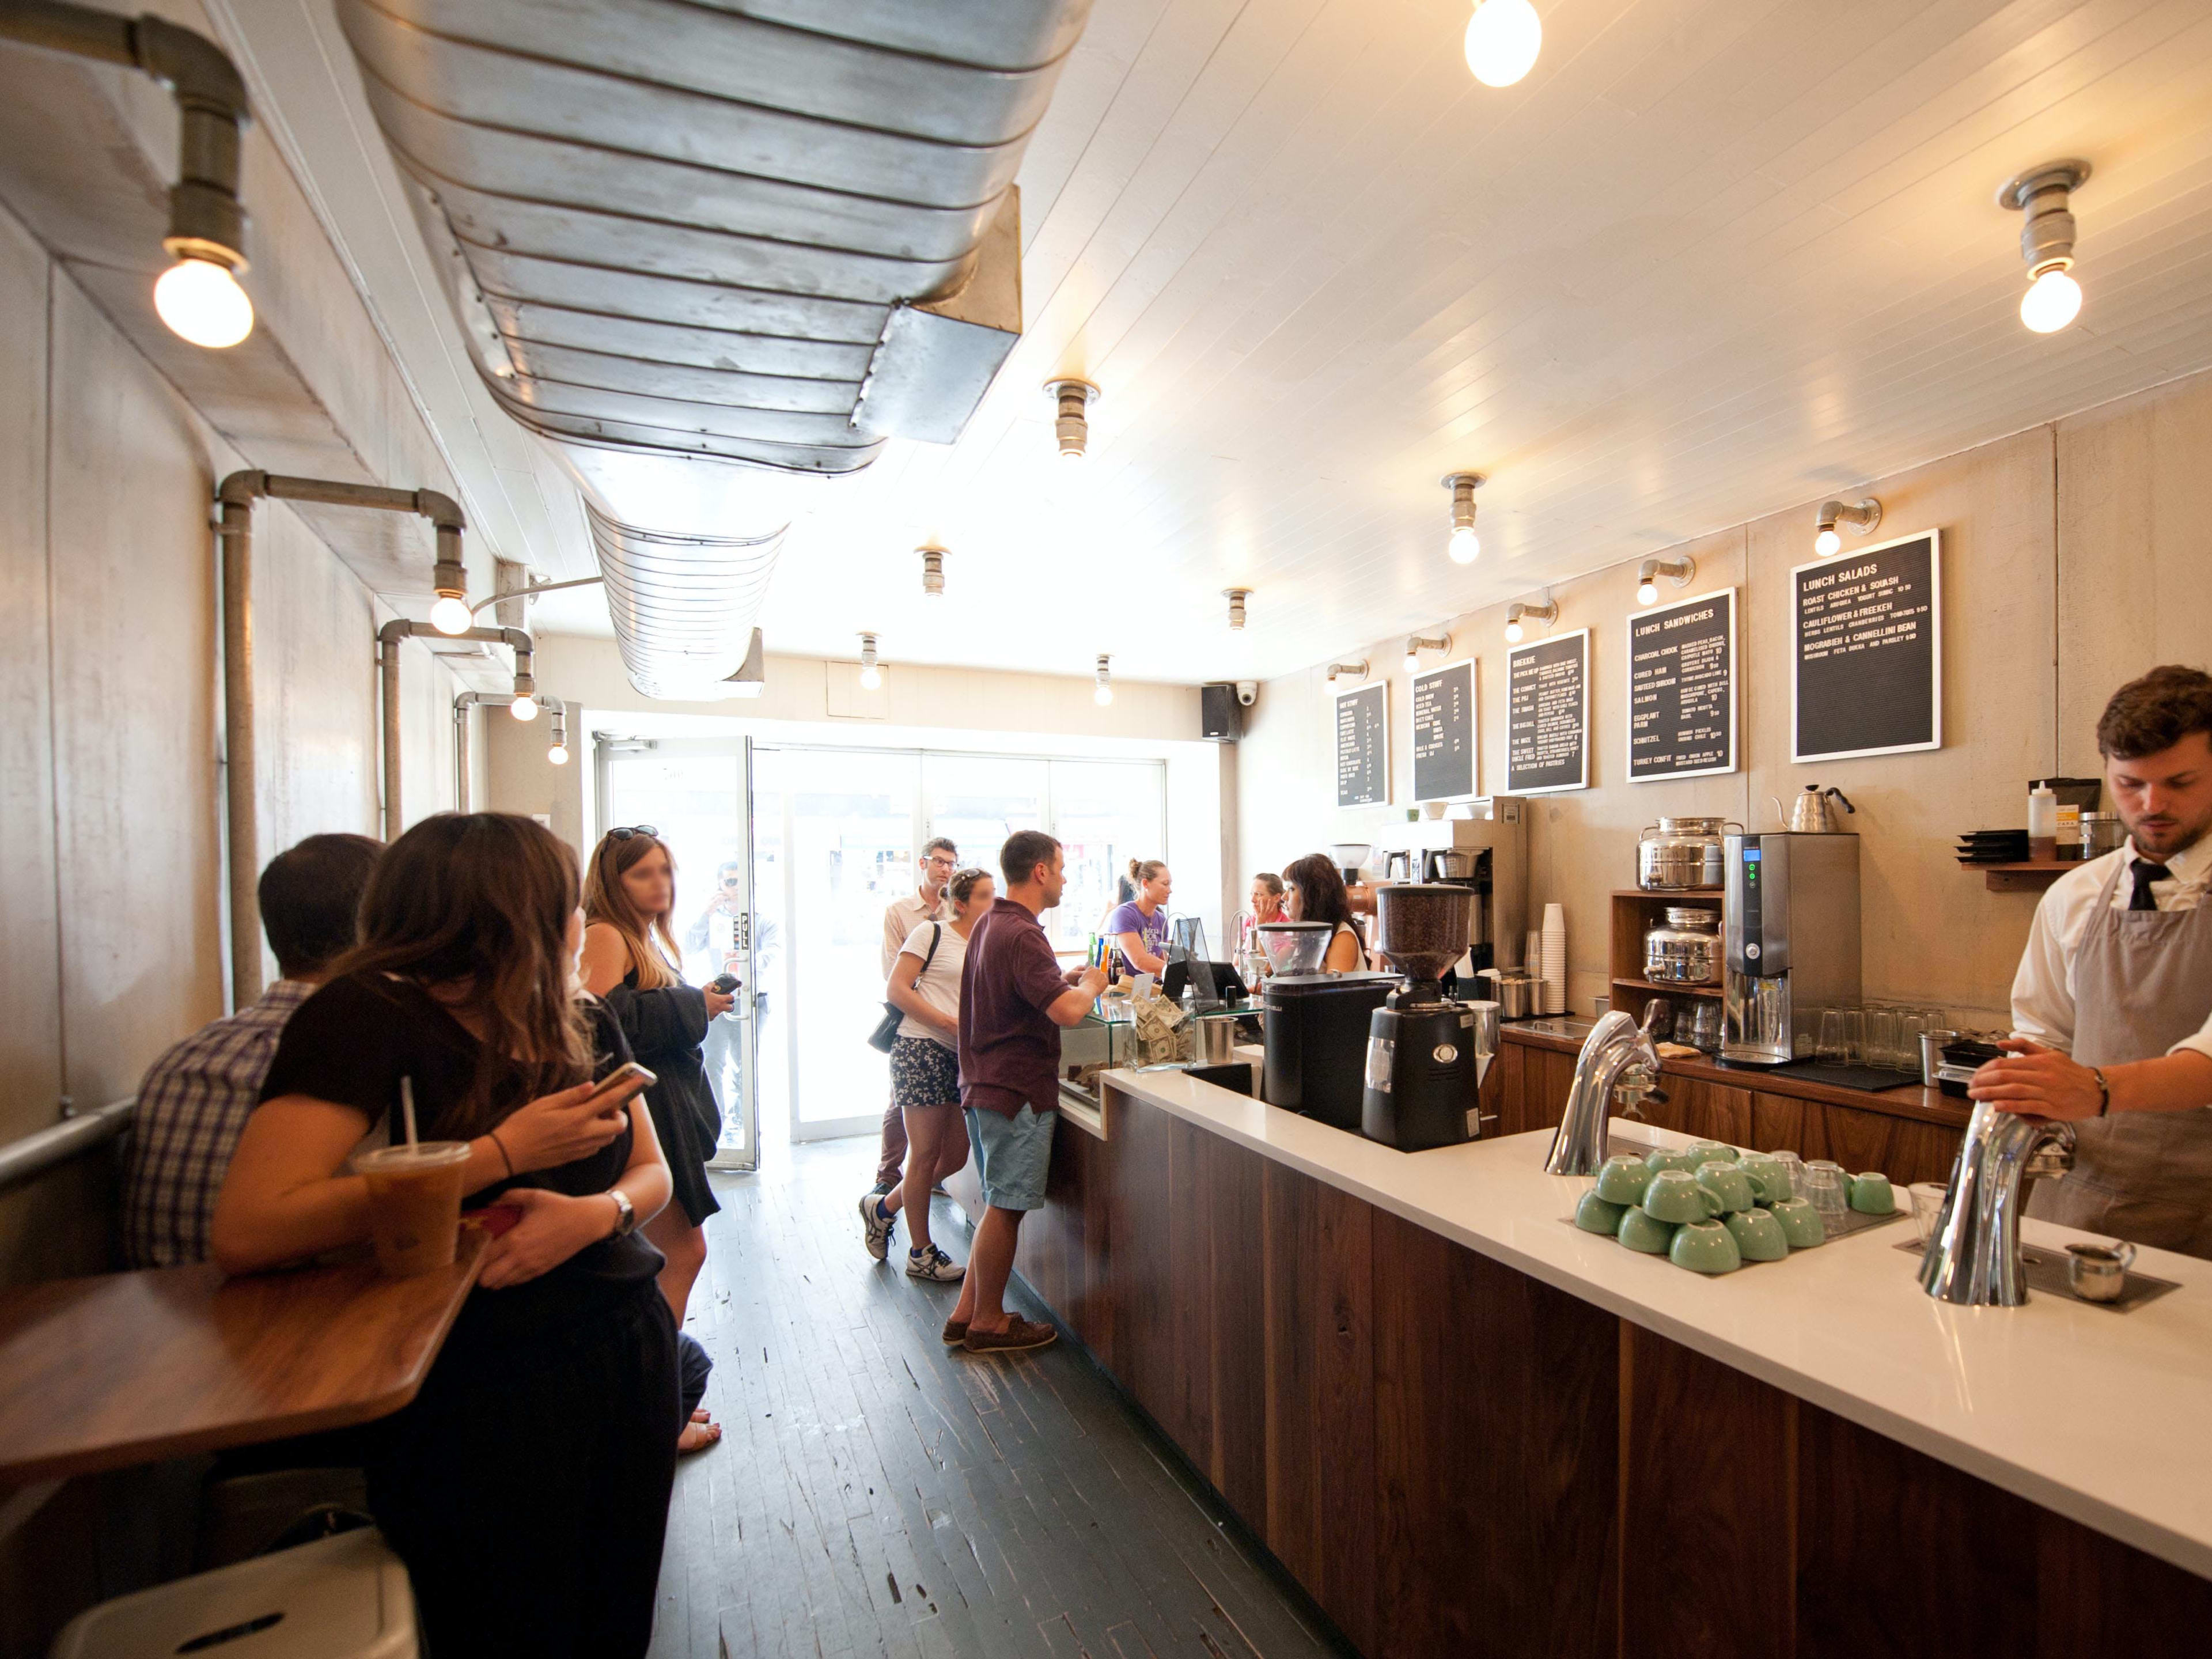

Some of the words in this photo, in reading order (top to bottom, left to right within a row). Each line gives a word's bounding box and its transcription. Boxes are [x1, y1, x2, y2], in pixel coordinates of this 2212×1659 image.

[1804, 575, 1835, 592] LUNCH
[1839, 564, 1877, 582] SALADS
[1803, 594, 1825, 607] ROAST
[1828, 586, 1859, 600] CHICKEN
[1870, 576, 1899, 590] SQUASH
[1805, 605, 1824, 614] LENTILS
[1830, 599, 1851, 608] ARUGULA
[1857, 593, 1876, 601] YOGURT
[1803, 612, 1853, 628] CAULIFLOWER
[1859, 602, 1893, 616] FREEKEH
[1823, 624, 1844, 633] LENTILS
[1849, 615, 1884, 628] CRANBERRIES
[1890, 608, 1915, 619] TOMATOES
[1636, 623, 1660, 637] LUNCH
[1664, 609, 1714, 629] SANDWICHES
[1804, 637, 1843, 652] MOGRABIEH
[1853, 626, 1896, 641] CANNELLINI
[1897, 622, 1916, 632] BEAN
[1882, 635, 1904, 645] PARSLEY
[1634, 650, 1660, 661] CHARCOAL
[1634, 670, 1652, 679] CURED
[1654, 667, 1666, 675] HAM
[1415, 684, 1428, 693] COLD
[1429, 680, 1442, 689] STUFF
[1634, 682, 1656, 692] SAUTEED
[1634, 694, 1657, 704] SALMON
[1634, 711, 1660, 722] EGGPLANT
[1634, 721, 1648, 729] PARM
[1634, 735, 1660, 745] SCHNITZEL
[1634, 757, 1653, 766] TURKEY
[1653, 755, 1672, 763] CONFIT
